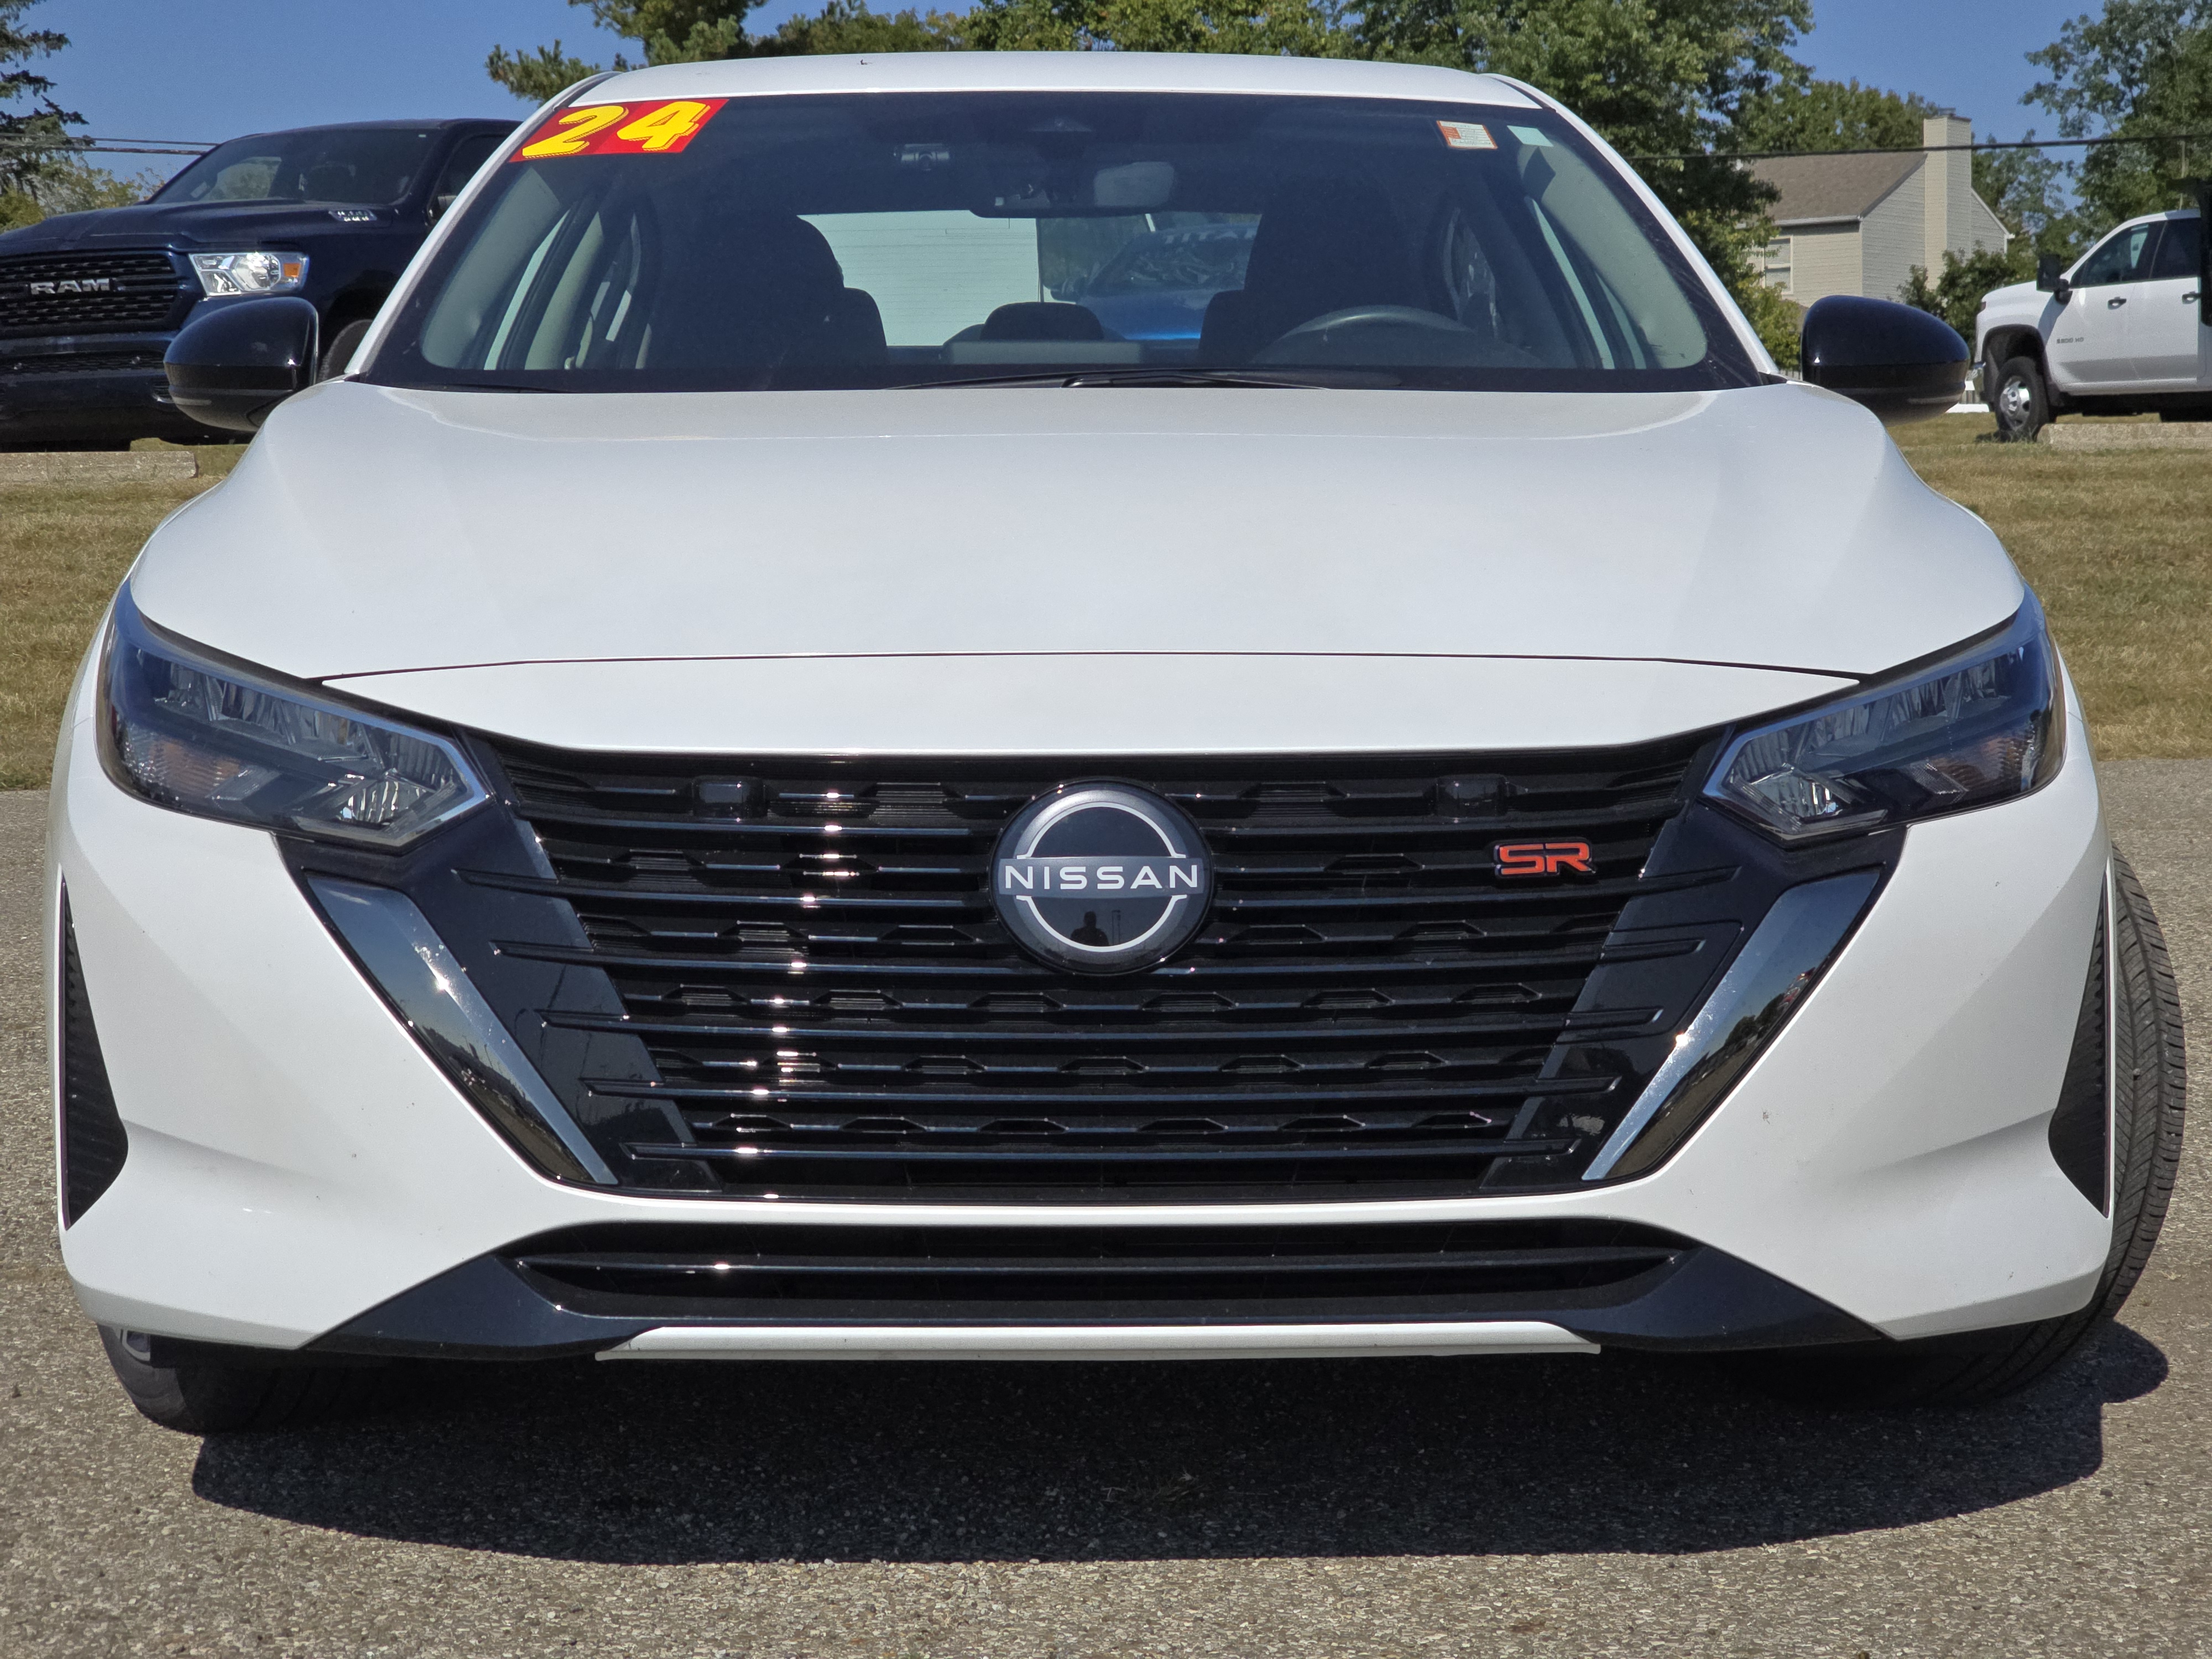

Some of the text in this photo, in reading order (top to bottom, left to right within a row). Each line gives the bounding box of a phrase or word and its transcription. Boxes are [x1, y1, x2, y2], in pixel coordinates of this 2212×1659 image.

[522, 101, 711, 158] 24
[30, 278, 110, 295] RAM
[1499, 842, 1592, 875] SR
[1005, 865, 1197, 889] NISSAN
